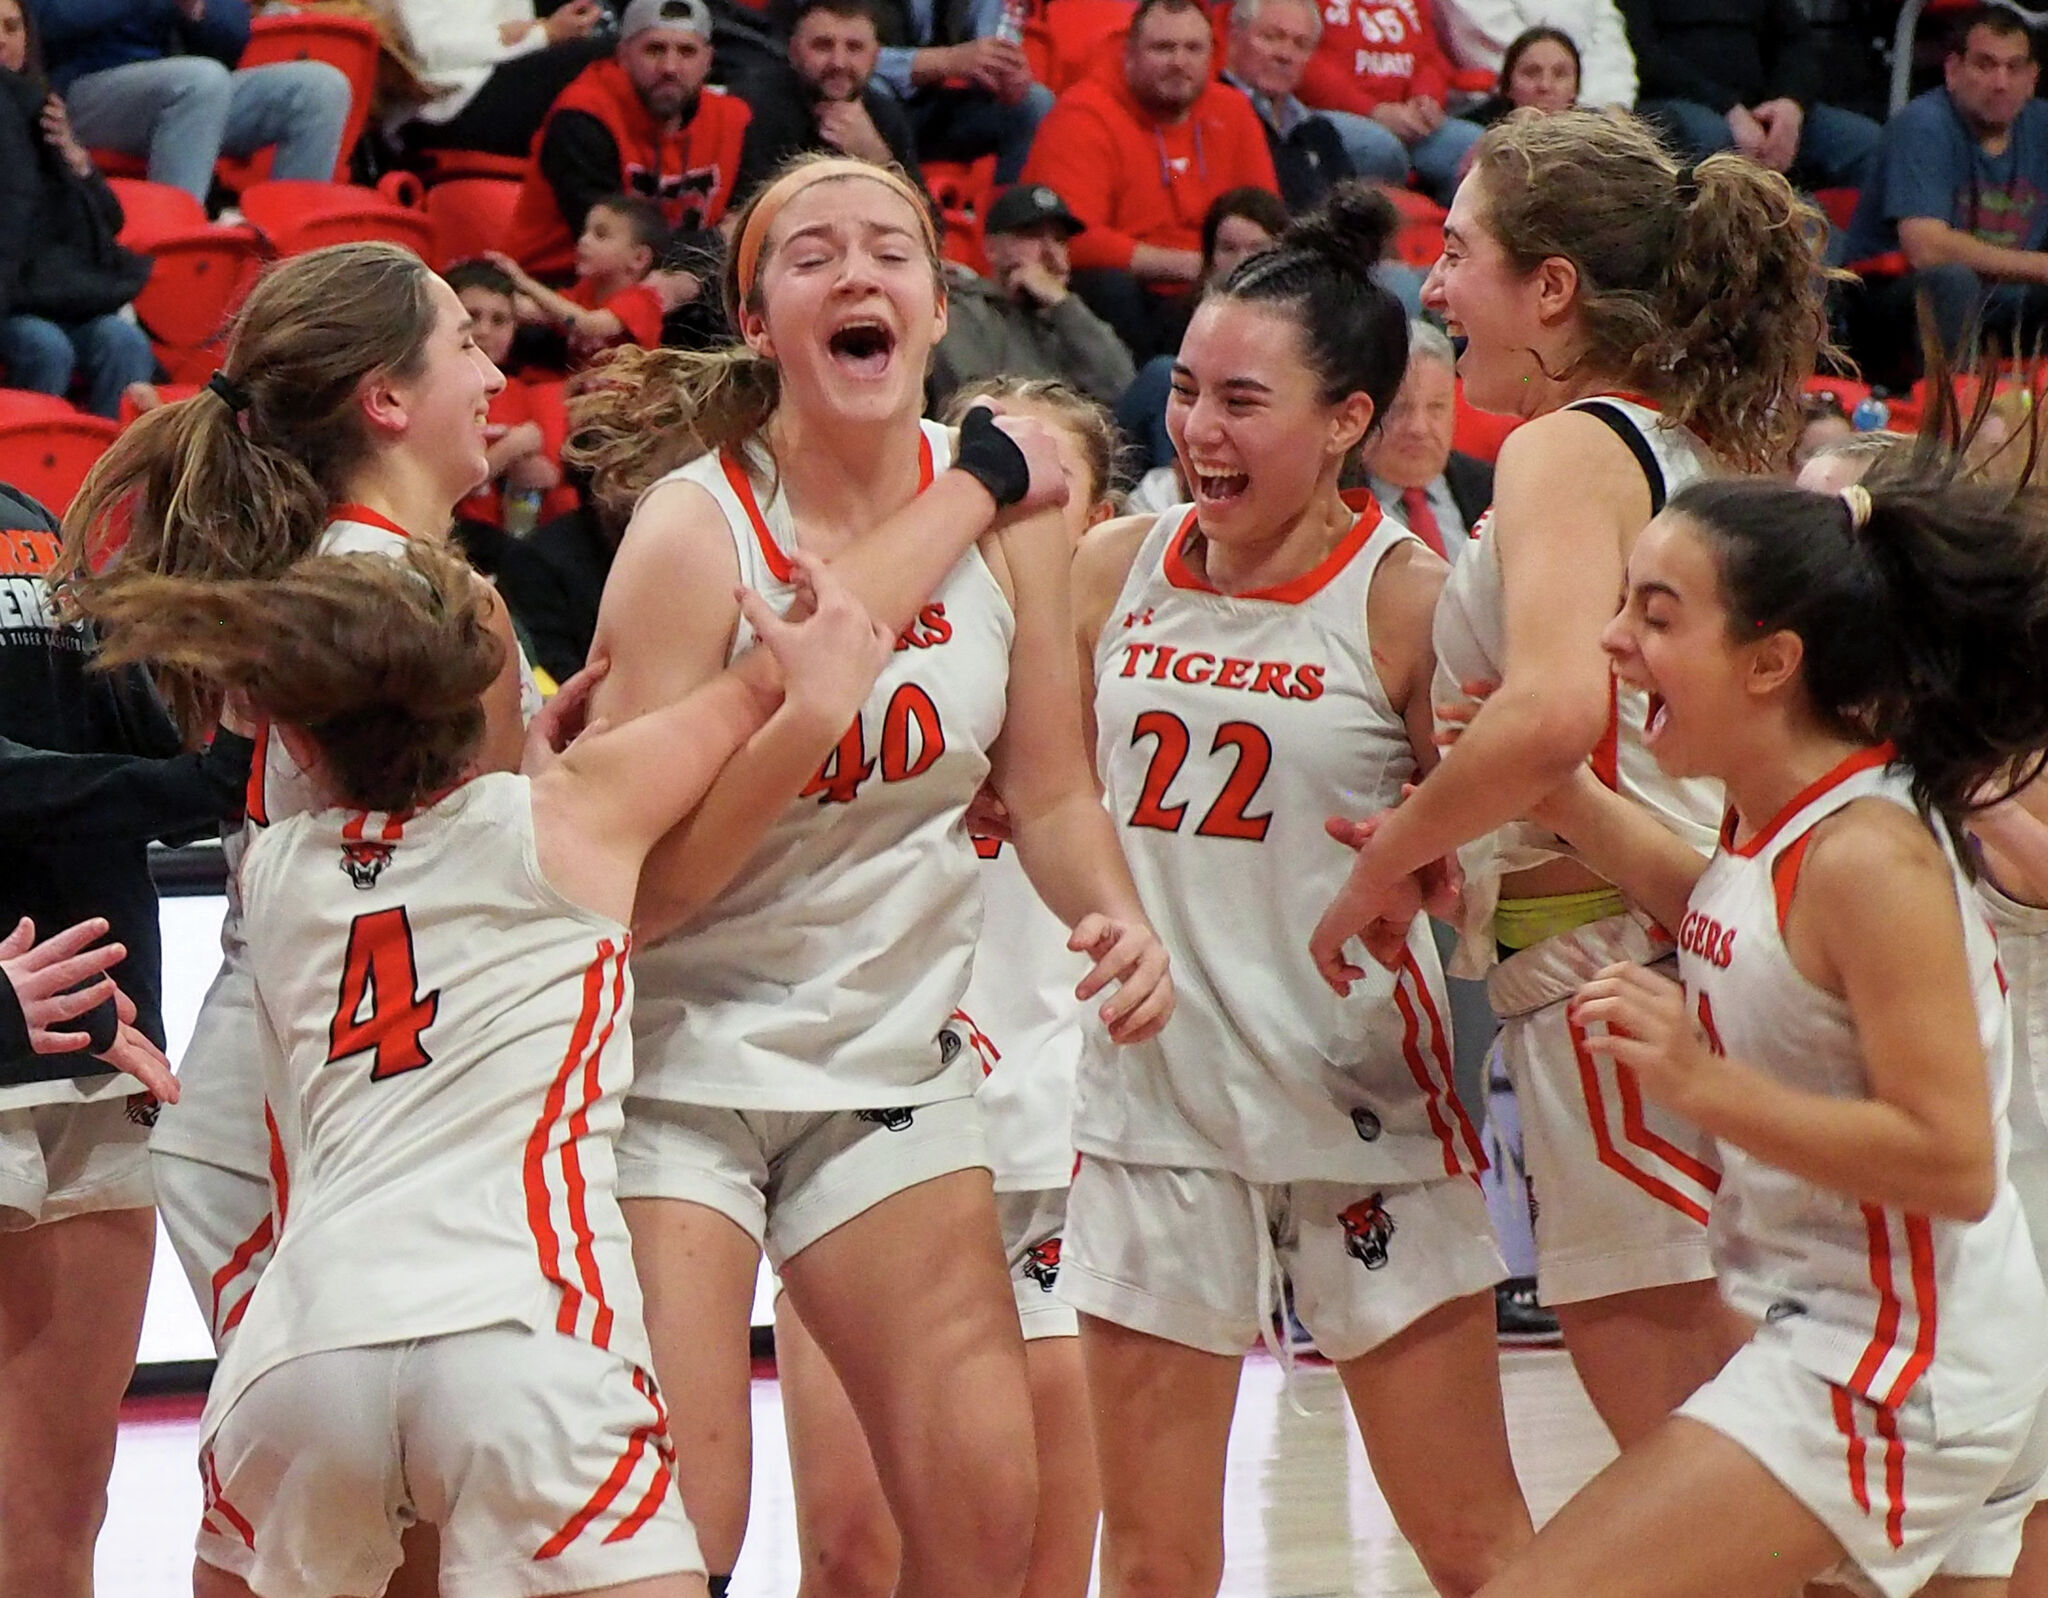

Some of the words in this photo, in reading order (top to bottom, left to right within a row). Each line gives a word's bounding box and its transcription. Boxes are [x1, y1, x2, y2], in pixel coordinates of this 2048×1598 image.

[11, 632, 41, 647] TIGER
[1119, 643, 1325, 701] TIGERS
[799, 682, 946, 804] 40
[1128, 709, 1273, 842] 22
[324, 905, 441, 1083] 4
